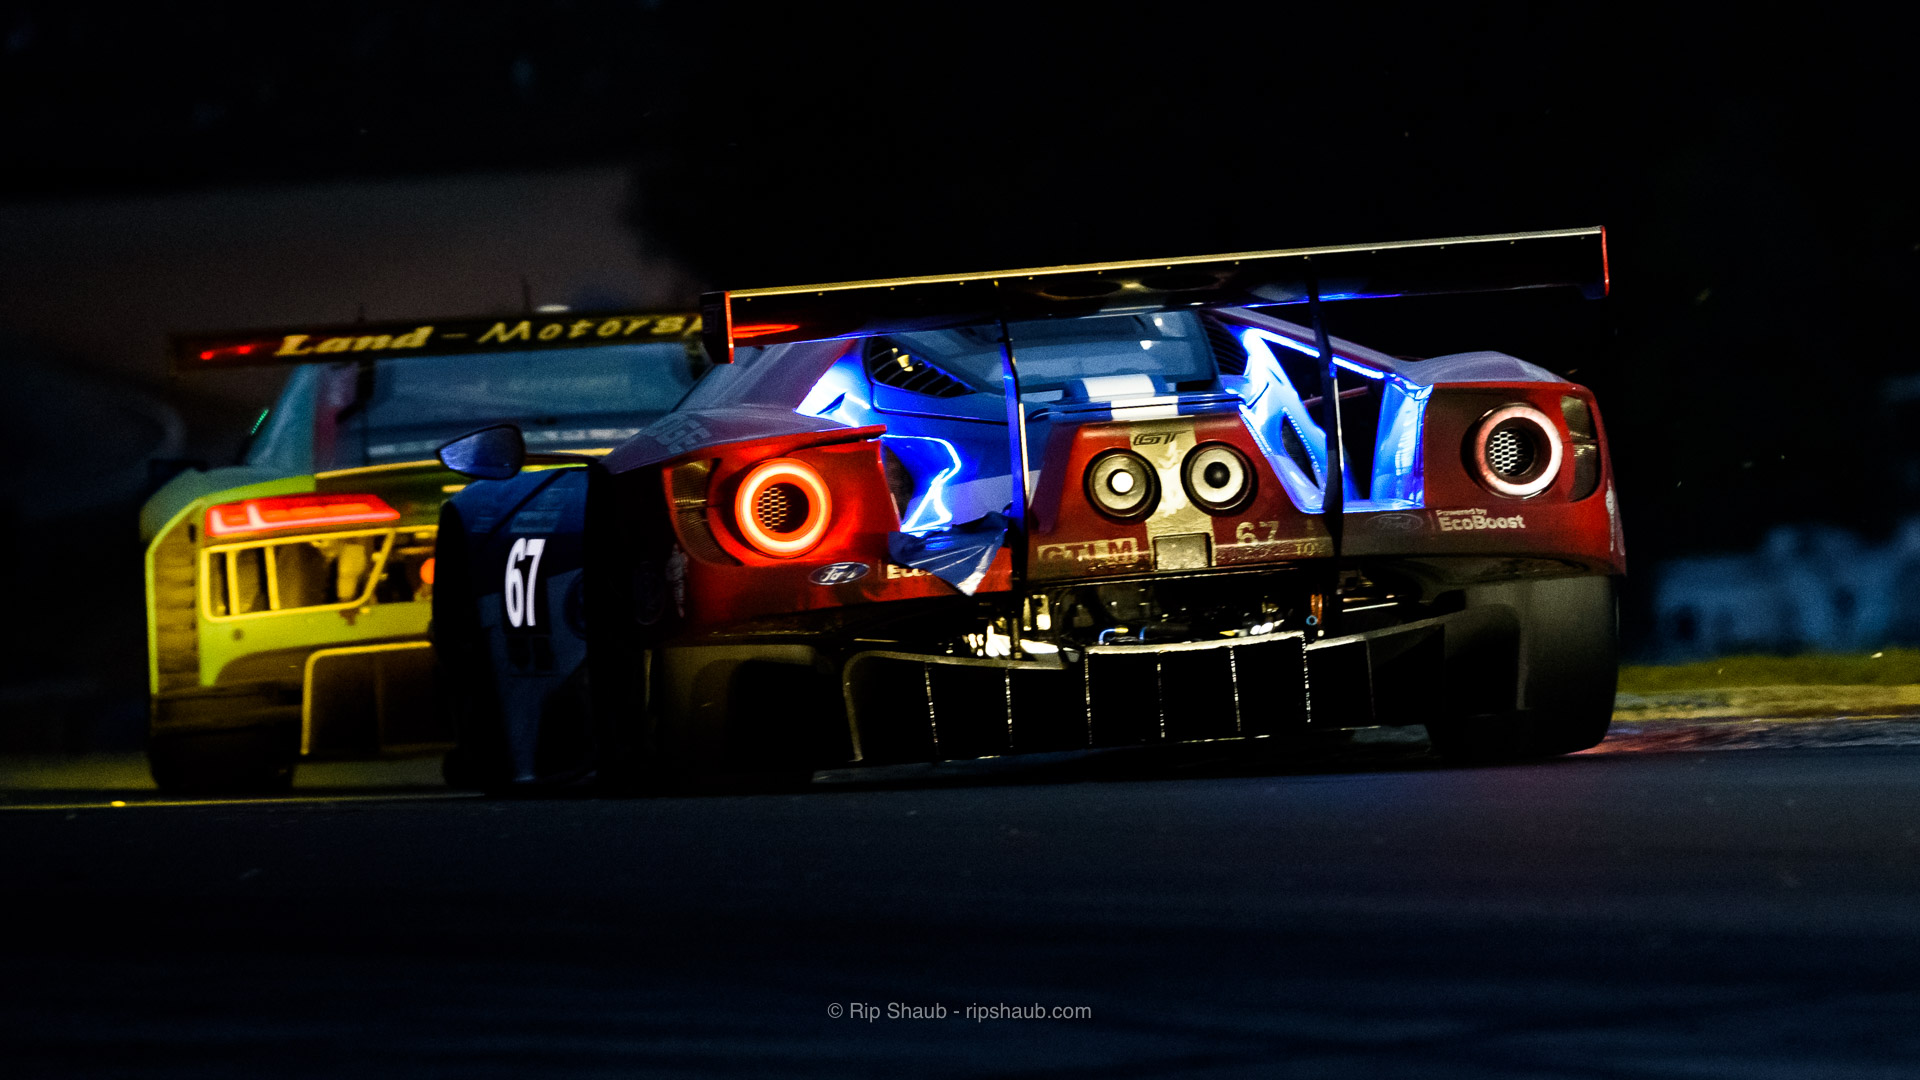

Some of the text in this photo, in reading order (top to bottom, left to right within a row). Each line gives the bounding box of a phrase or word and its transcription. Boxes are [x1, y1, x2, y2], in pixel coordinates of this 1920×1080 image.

[274, 325, 435, 357] Land
[1133, 430, 1192, 446] GT
[1236, 520, 1280, 544] 67
[1438, 515, 1526, 532] EcoBoost
[504, 537, 546, 628] 67
